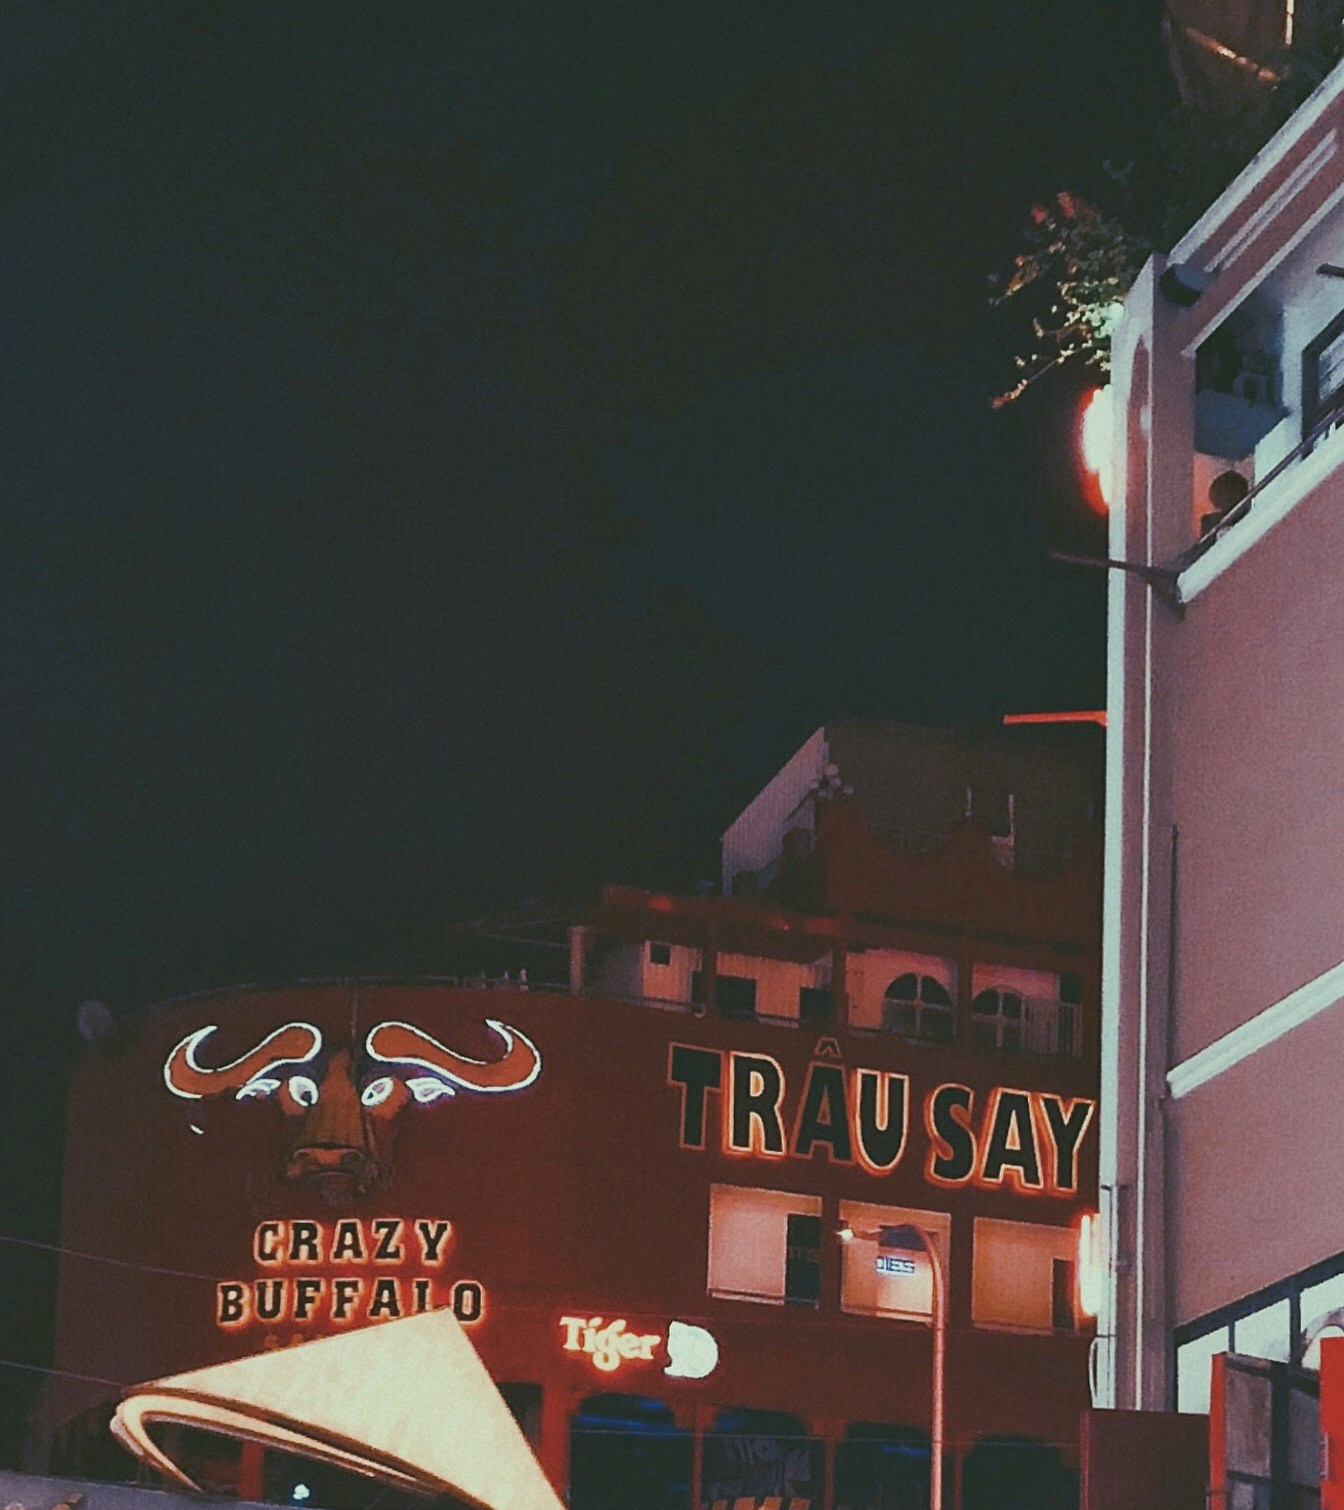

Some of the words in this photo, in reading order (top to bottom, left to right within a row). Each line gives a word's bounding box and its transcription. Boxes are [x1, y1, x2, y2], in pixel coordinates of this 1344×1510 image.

[668, 1037, 909, 1172] TRÂU
[927, 1084, 1096, 1194] SAY
[254, 1219, 452, 1265] CRAZY
[217, 1277, 485, 1324] BUFFALO
[559, 1316, 661, 1372] Tiger
